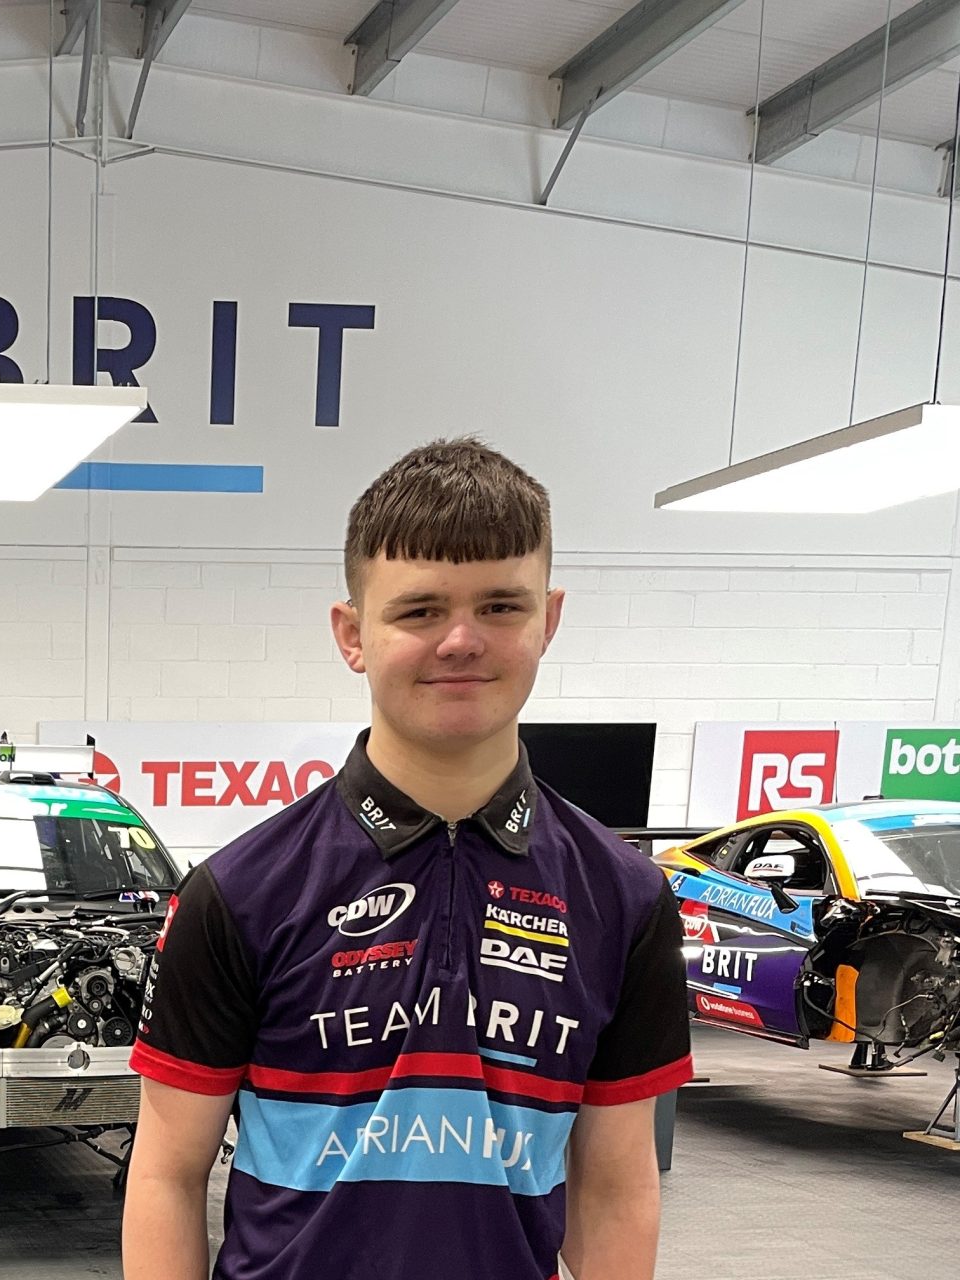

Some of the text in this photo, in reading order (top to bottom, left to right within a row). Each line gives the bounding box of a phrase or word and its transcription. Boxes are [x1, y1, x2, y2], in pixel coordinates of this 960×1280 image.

[141, 760, 335, 807] TEXAC
[748, 752, 826, 811] RS
[361, 796, 397, 831] BRIT
[505, 790, 527, 833] BRIT
[107, 826, 156, 850] 70
[327, 893, 396, 927] CDW
[509, 886, 567, 913] TEXACO
[699, 884, 778, 919] ADRIANFLUX
[331, 938, 418, 968] ODYSSEY
[333, 958, 413, 978] BATTERY
[480, 938, 568, 970] DAF
[702, 948, 758, 982] BRIT
[310, 987, 440, 1049] TEAM
